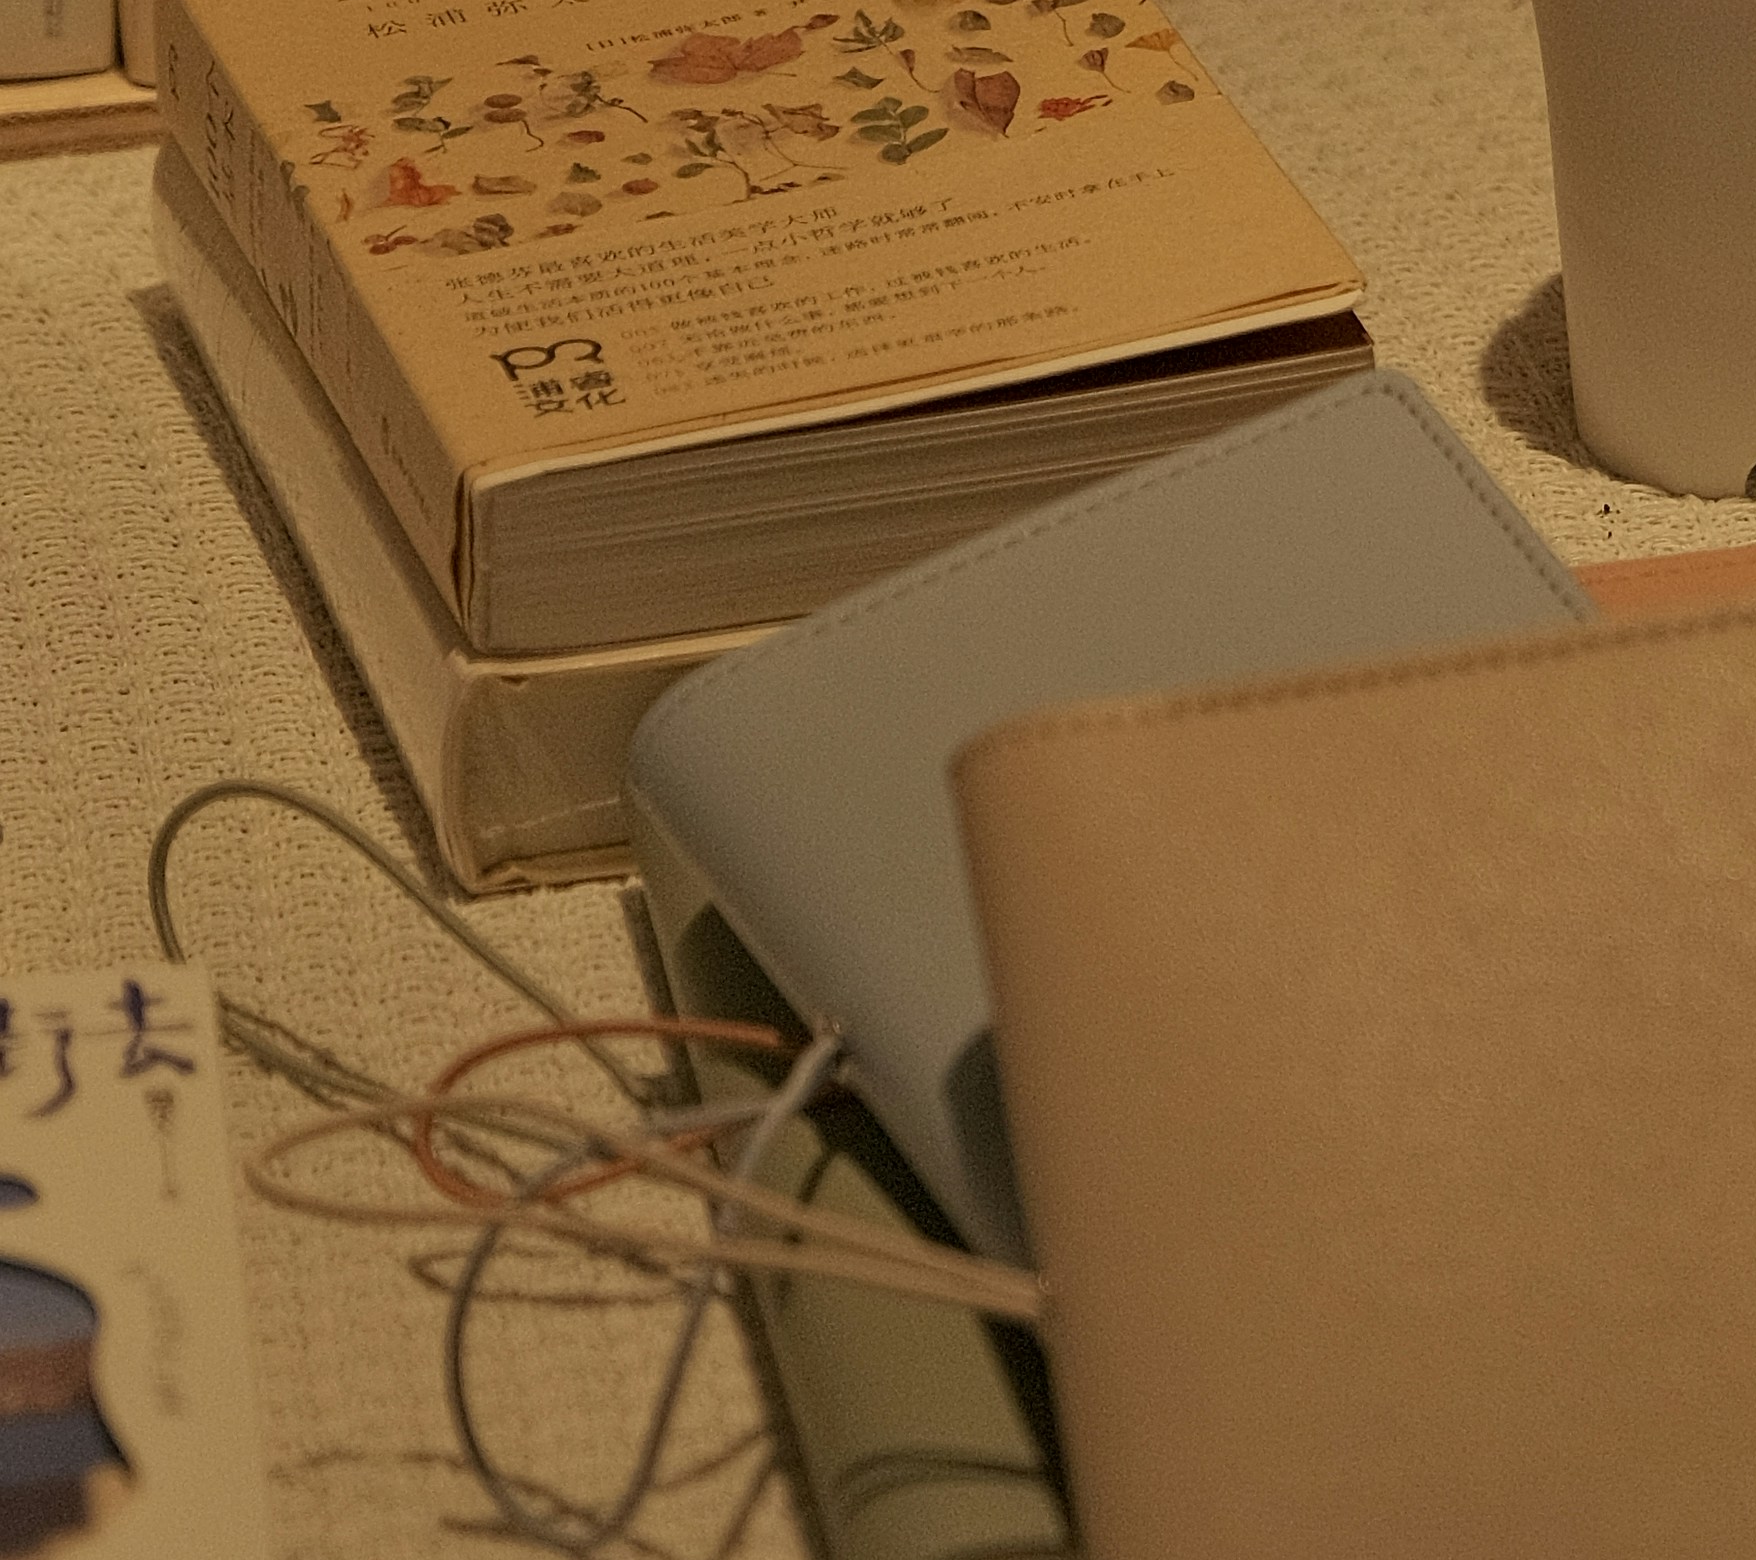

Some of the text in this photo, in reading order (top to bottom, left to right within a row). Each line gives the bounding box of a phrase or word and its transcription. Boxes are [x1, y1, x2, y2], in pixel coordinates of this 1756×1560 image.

[444, 204, 838, 292] 张德芬最喜欢的生活美学大师
[530, 388, 626, 418] 文化
